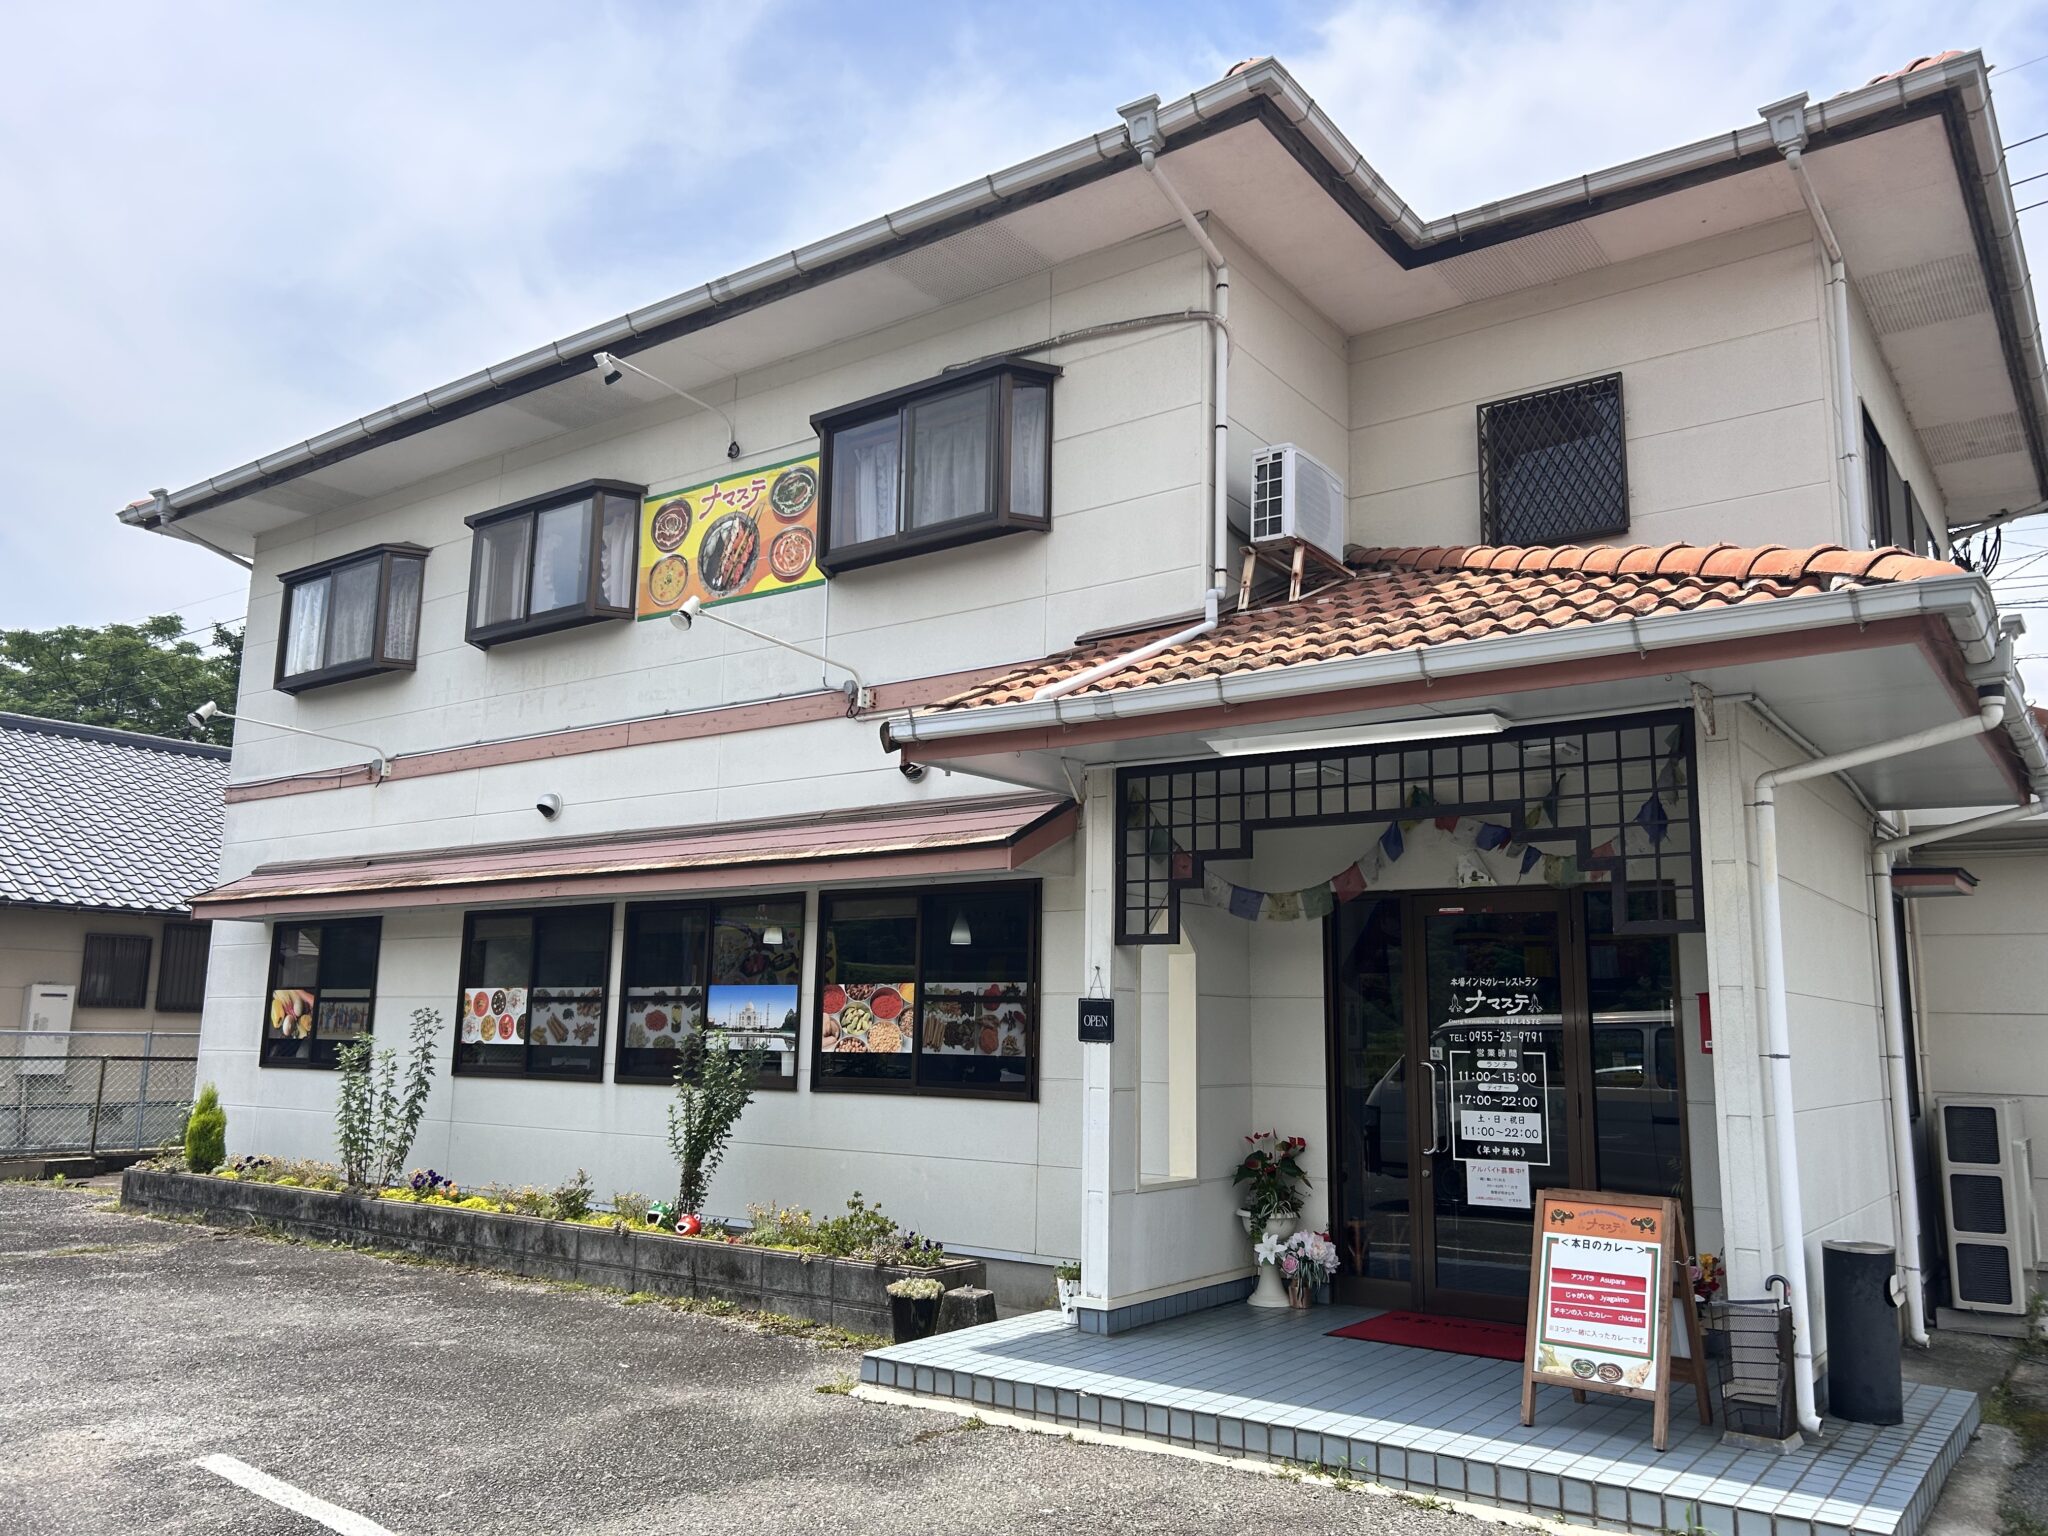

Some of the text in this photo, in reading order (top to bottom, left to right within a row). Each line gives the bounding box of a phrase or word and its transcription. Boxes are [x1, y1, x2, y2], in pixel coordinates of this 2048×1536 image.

[699, 479, 767, 520] ナマステ
[1450, 977, 1539, 987] 本場インドカレーレストラン
[1464, 989, 1529, 1015] ナマステ
[1083, 1014, 1108, 1027] OPEN
[1476, 1048, 1518, 1058] 営業時間
[1477, 1114, 1525, 1125] 土・日・祝日
[1585, 1218, 1622, 1233] ナマステ
[1571, 1273, 1626, 1286] アスパラ Asupara
[1565, 1291, 1629, 1304] じゃがいも Jyagaimo
[1553, 1307, 1642, 1323] チキンの入ったカレー chicken
